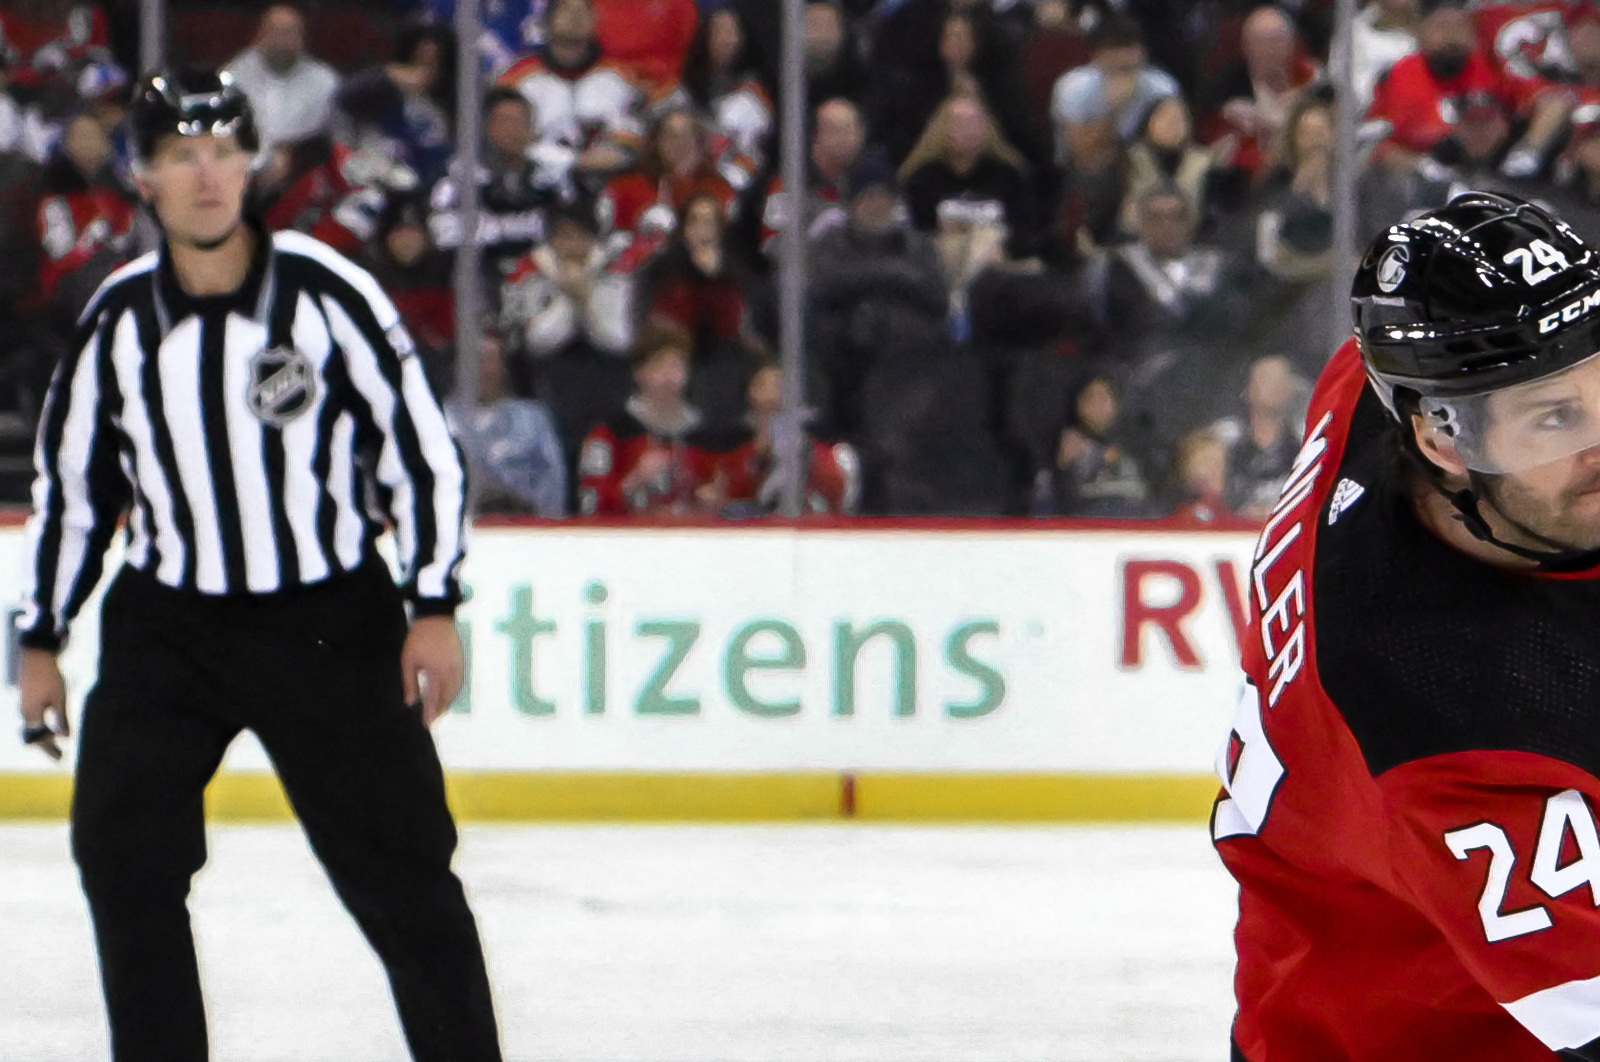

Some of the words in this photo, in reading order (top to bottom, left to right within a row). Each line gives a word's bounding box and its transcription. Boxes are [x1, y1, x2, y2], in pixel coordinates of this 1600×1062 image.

[1503, 238, 1572, 286] 24
[1252, 410, 1334, 708] MILLER
[451, 581, 1006, 720] itizens
